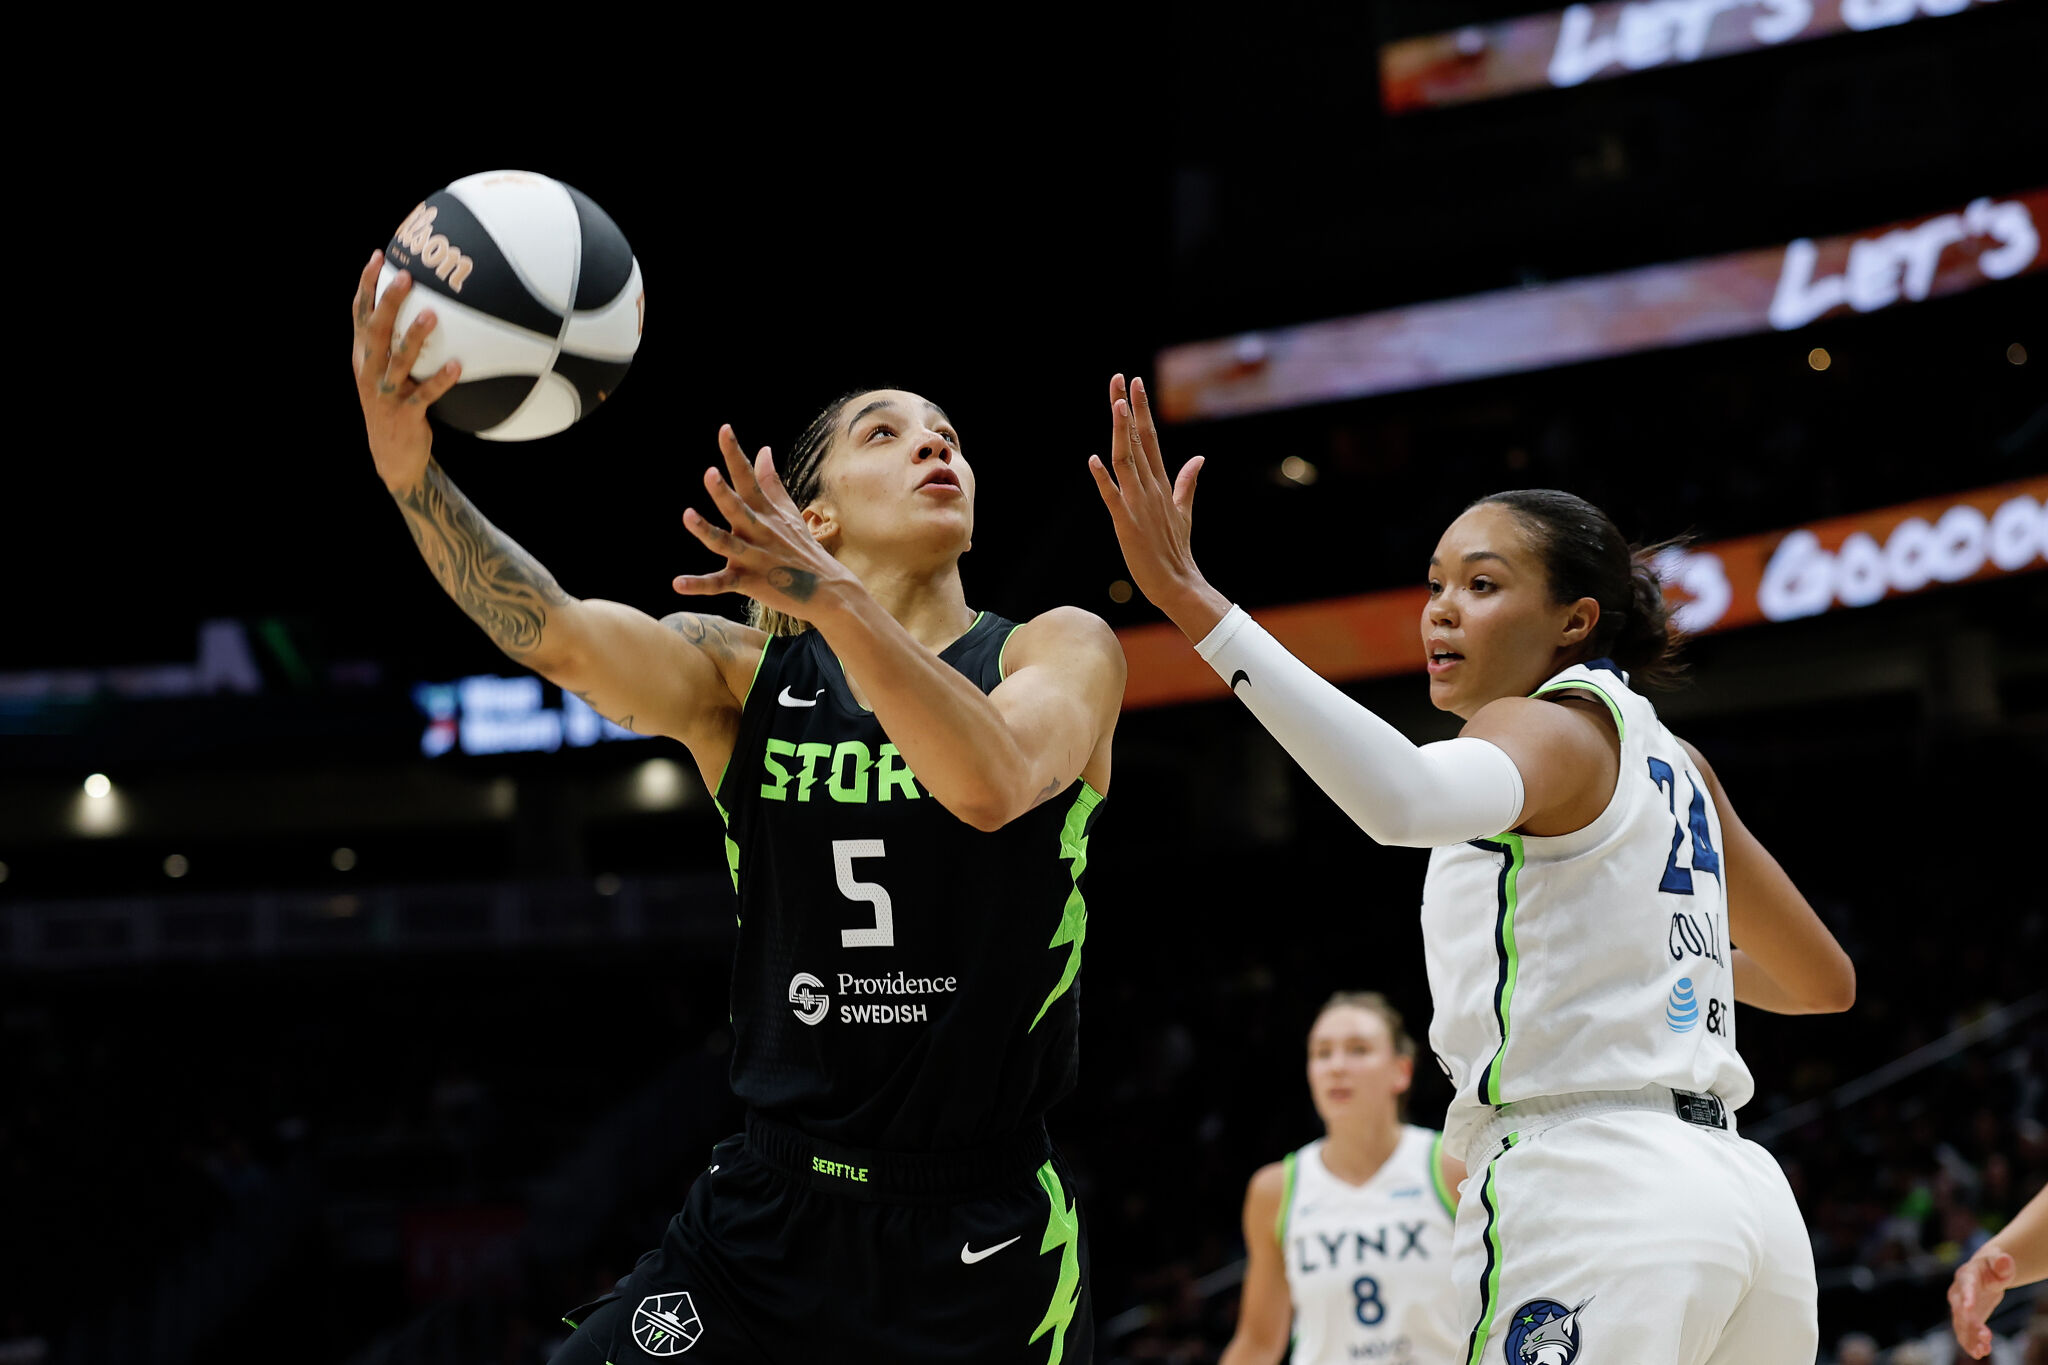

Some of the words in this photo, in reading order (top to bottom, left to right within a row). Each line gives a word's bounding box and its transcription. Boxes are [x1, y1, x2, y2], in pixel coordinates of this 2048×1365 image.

[1768, 197, 2040, 331] LET'S
[1757, 494, 2048, 622] GOOOO
[760, 738, 935, 804] STOR
[1647, 756, 1721, 899] 24
[832, 839, 894, 948] 5
[837, 971, 957, 996] Providence
[840, 1004, 928, 1024] SWEDISH
[812, 1156, 868, 1182] SEATTLE
[1296, 1221, 1430, 1275] LYNX
[1353, 1276, 1385, 1326] 8
